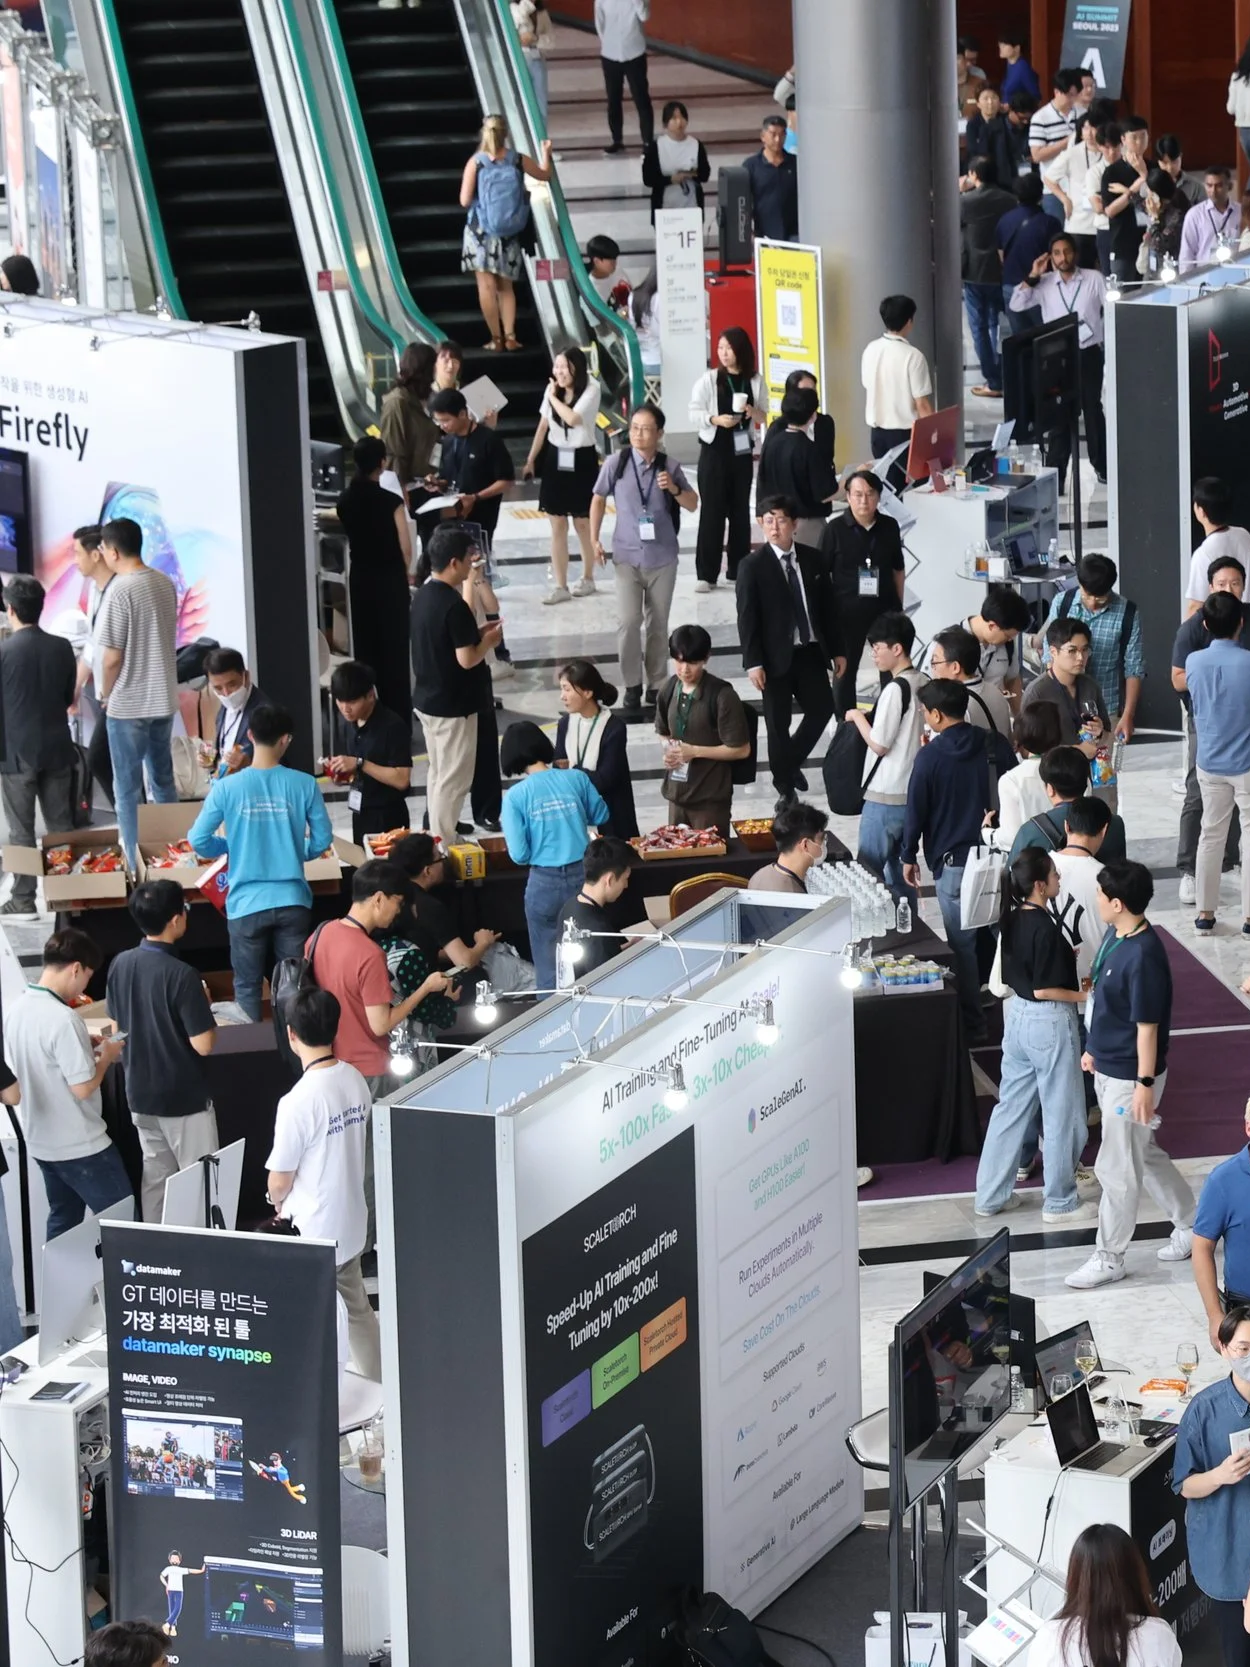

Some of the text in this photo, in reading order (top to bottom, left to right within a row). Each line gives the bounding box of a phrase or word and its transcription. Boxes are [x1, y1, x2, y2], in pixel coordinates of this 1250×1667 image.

[1073, 21, 1098, 31] SEOUL
[1081, 47, 1106, 88] A
[677, 231, 697, 249] 1F
[775, 278, 785, 287] QR
[1223, 391, 1249, 408] Automotive
[1223, 404, 1249, 421] Generative
[0, 404, 89, 462] Firefly
[602, 1086, 613, 1114] AI
[615, 1065, 656, 1104] Training
[657, 1044, 677, 1074] and
[679, 1013, 737, 1063] Fine-Tuning
[738, 998, 749, 1023] At
[599, 1057, 733, 1164] 5x-100x 3x-10x
[760, 1077, 807, 1122] ScaleGenAI.
[749, 1138, 810, 1194] Get GPUs Like A100
[754, 1193, 767, 1211] and
[767, 1179, 784, 1203] H100
[738, 1211, 824, 1285] Run Experiments in Multiple
[136, 1264, 182, 1277] datamaker
[546, 1228, 678, 1336] Speed-Up AI Training and Fine
[749, 1272, 771, 1298] Clouds
[122, 1284, 269, 1316] GT 데이터를 만드는
[568, 1271, 659, 1351] Tuning by 10x-200x!
[122, 1310, 251, 1341] 가장 최적화 된 툴
[743, 1334, 759, 1353] Save
[759, 1321, 775, 1340] Cost
[775, 1313, 785, 1328] On
[785, 1302, 798, 1319] The
[122, 1336, 272, 1364] datamaker synapse
[763, 1342, 806, 1382] Supported Clouds
[122, 1373, 178, 1386] IMAGE, VIDEO
[280, 1528, 317, 1540] 3D LiDAR
[606, 1606, 639, 1641] Available For
